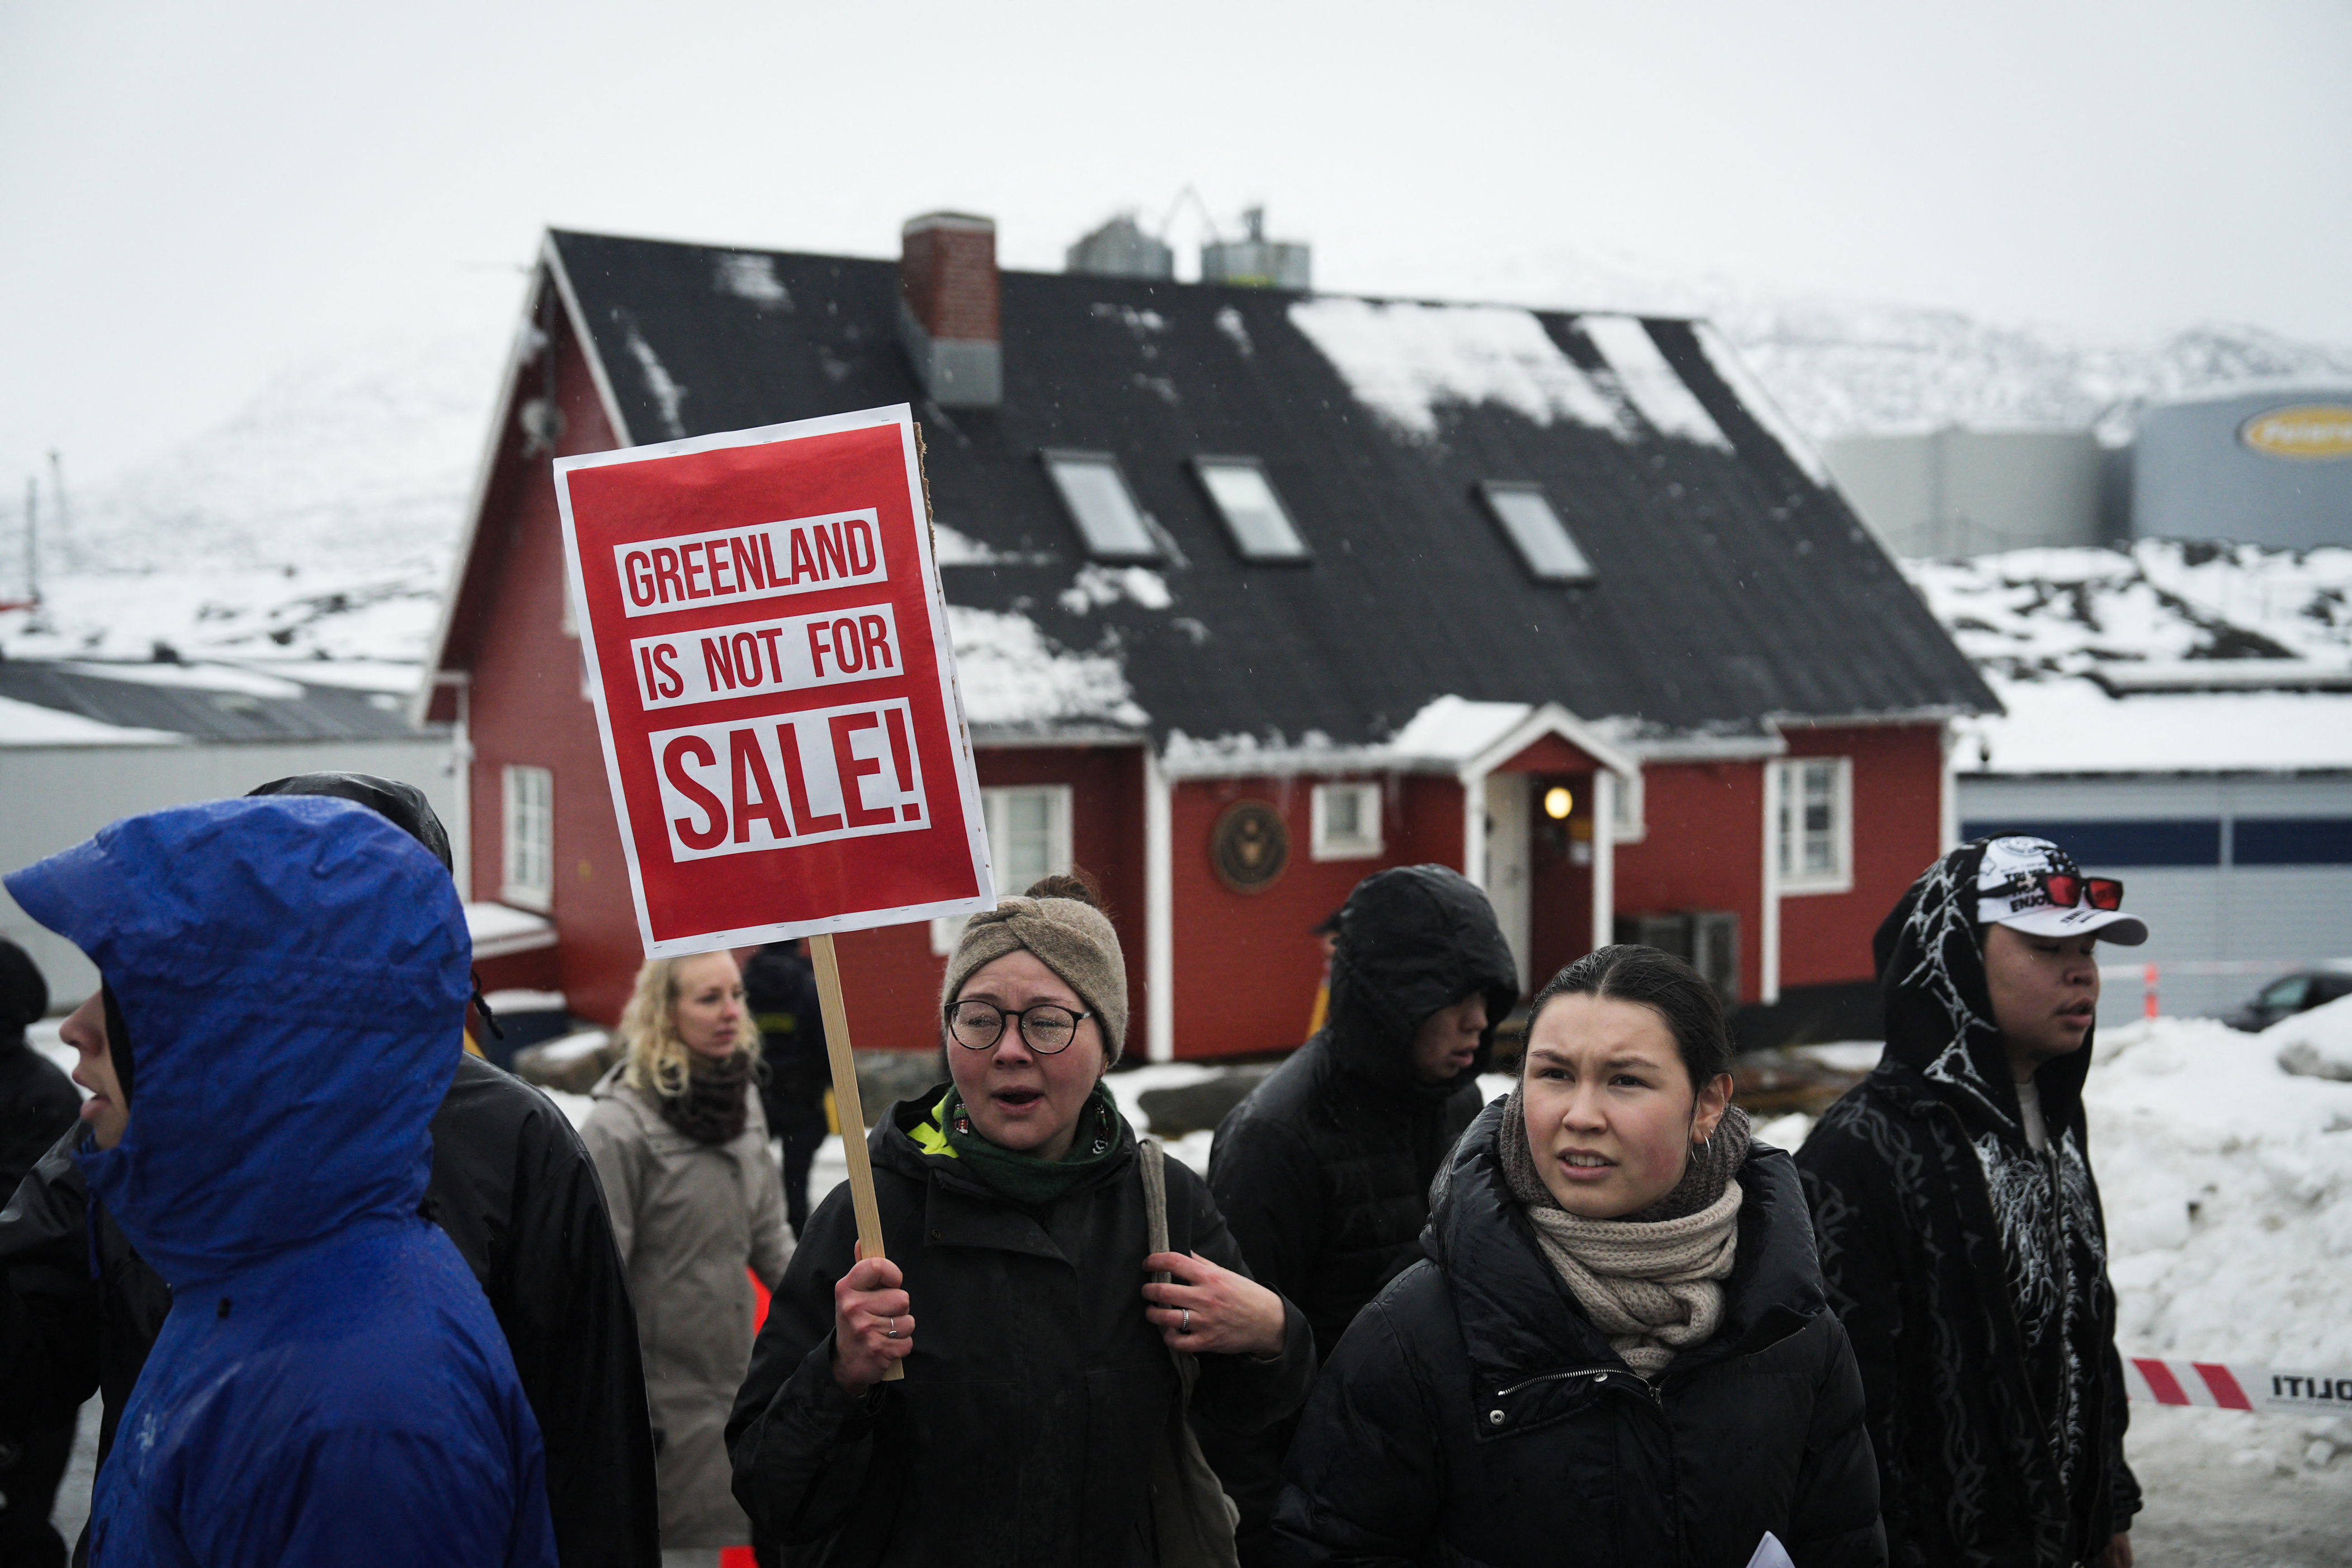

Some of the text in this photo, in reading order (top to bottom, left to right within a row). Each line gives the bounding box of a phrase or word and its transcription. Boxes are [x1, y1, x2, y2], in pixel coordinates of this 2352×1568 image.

[625, 519, 877, 607] GREENLAND
[640, 615, 894, 701] IS NOT FOR
[663, 707, 922, 851] SALE!
[2010, 894, 2050, 913] ENJO
